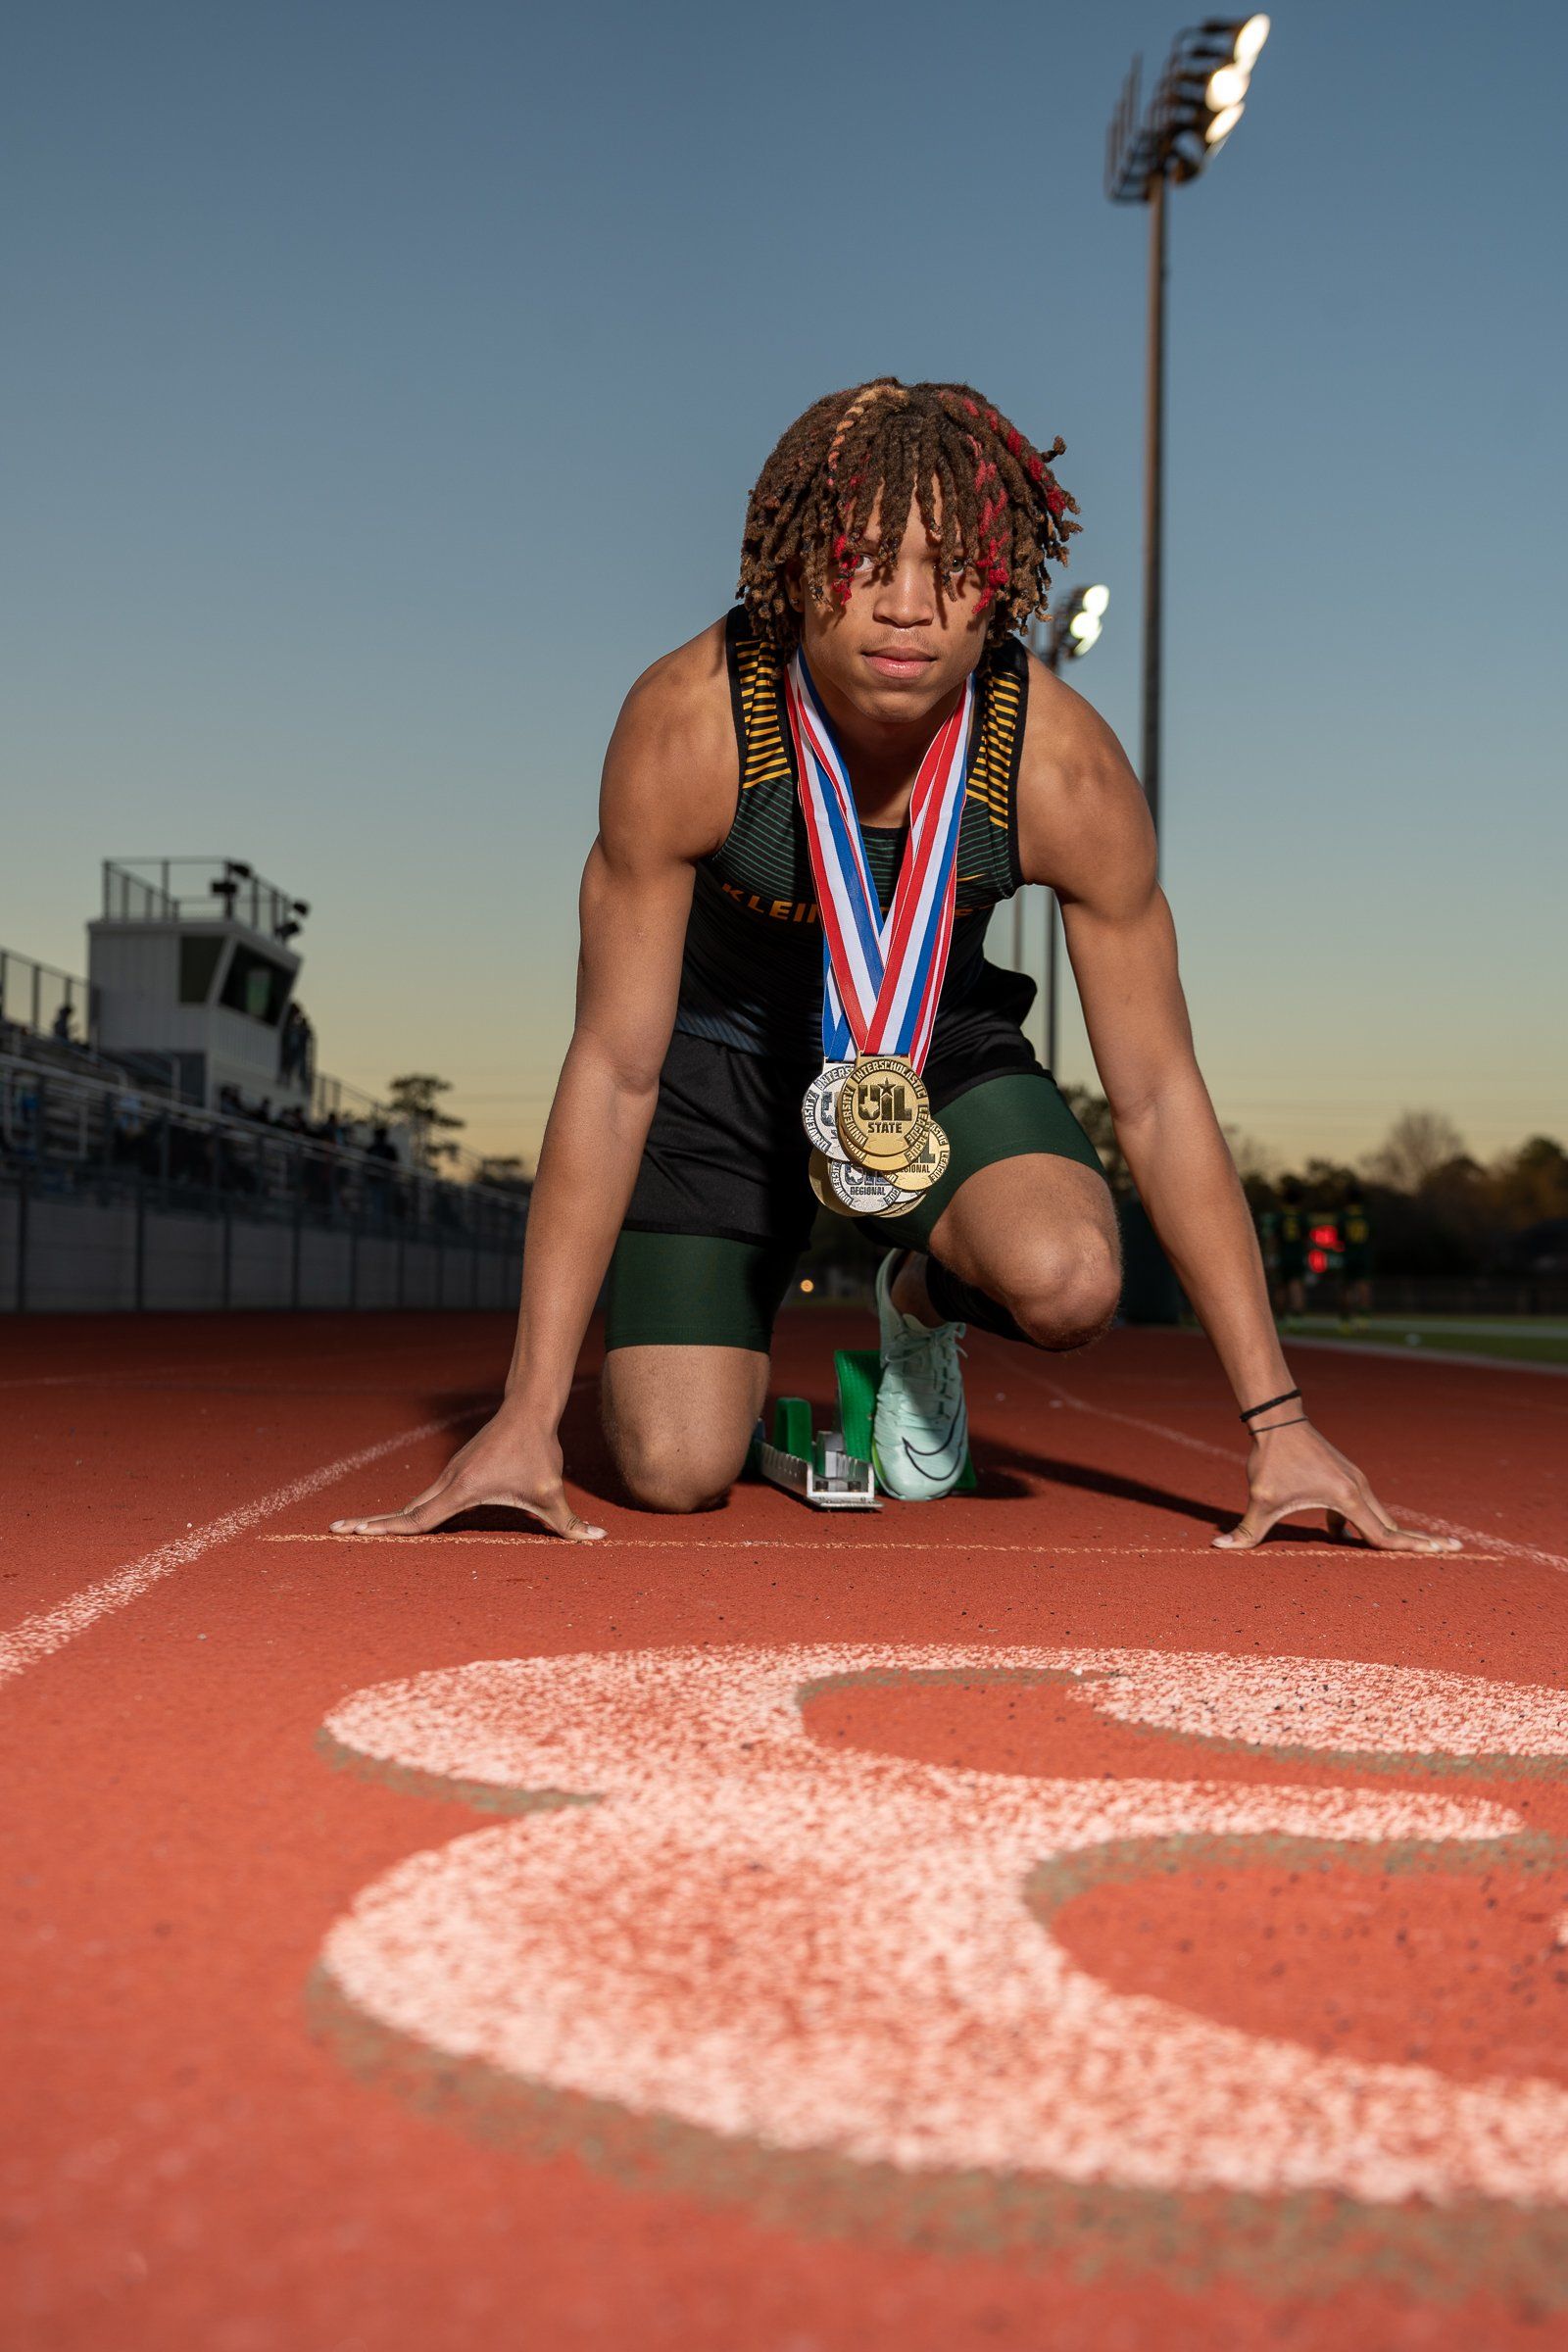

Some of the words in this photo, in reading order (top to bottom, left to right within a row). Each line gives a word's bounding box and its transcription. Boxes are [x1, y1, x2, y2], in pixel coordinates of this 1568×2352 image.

[854, 1060, 927, 1099] INTERSCHOLASTIC
[804, 1092, 831, 1152] UNIVERSITY
[842, 1085, 868, 1148] UNIVERSITY
[868, 1122, 902, 1133] STATE
[905, 1105, 928, 1145] LEAGUE
[850, 1187, 886, 1196] REGIONAL
